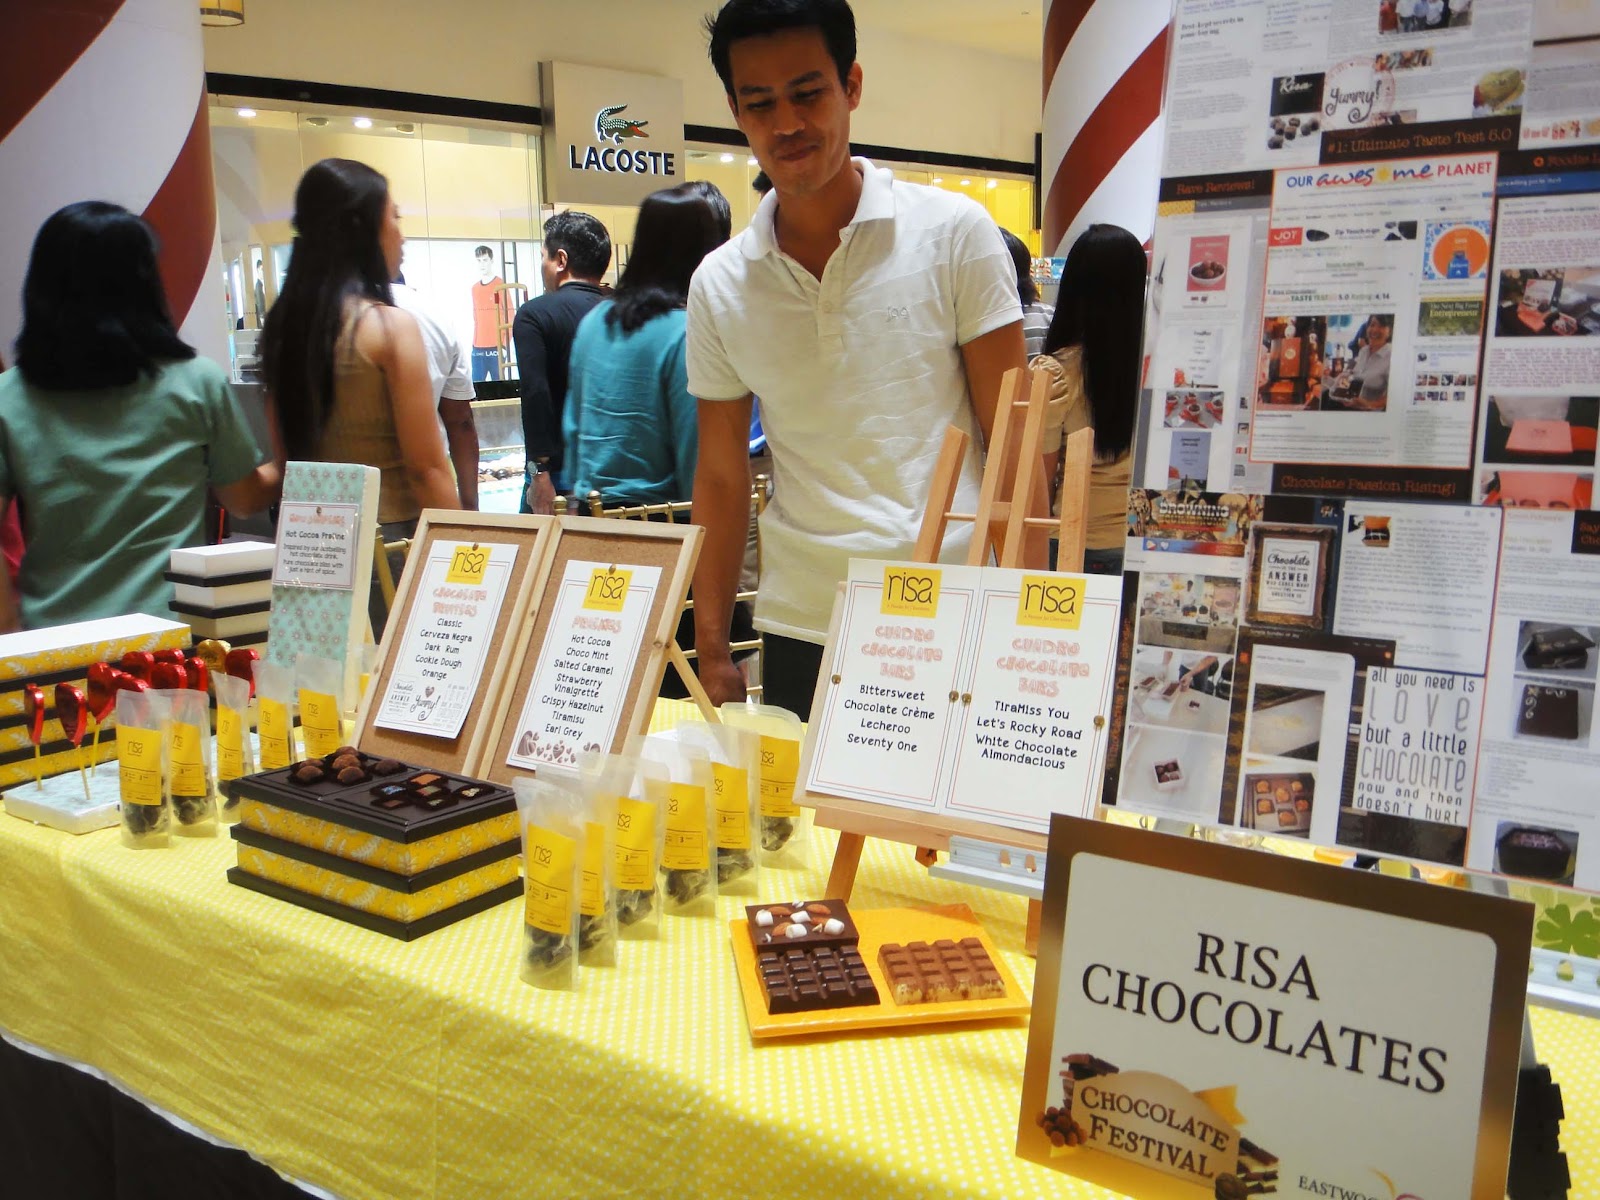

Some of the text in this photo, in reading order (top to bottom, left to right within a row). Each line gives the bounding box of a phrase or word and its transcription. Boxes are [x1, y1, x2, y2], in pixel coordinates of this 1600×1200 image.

[1351, 137, 1411, 153] Ultimate
[1413, 134, 1451, 148] Taste
[1455, 130, 1485, 144] Test
[569, 144, 675, 176] LACOSTE
[1286, 175, 1313, 188] OUR
[1437, 161, 1492, 178] PLANET
[1280, 475, 1456, 495] Chocolate Passion Rising!
[286, 530, 297, 538] Hot
[299, 530, 320, 539] Cocoa
[452, 549, 485, 574] risa
[1268, 553, 1310, 566] Chocolate
[589, 572, 625, 600] risa
[1268, 572, 1308, 582] ANSWER
[888, 572, 933, 604] risa
[1025, 580, 1076, 615] risa
[437, 618, 462, 628] Classic
[420, 629, 472, 643] Cerveza Negra
[571, 634, 611, 647] Hot Cocoa
[425, 642, 460, 654] Dark Rum
[566, 647, 609, 661] Choco Mint
[415, 655, 462, 669] Cookie Dough
[554, 659, 614, 675] Salted Caramel
[422, 669, 447, 680] Orange
[556, 673, 603, 690] Strawberry
[1371, 669, 1388, 683] all
[1395, 672, 1417, 688] you
[1424, 675, 1455, 691] need
[554, 683, 600, 698] Vinaigrette
[859, 684, 925, 701] Bittersweet
[541, 695, 604, 713] Crispy Hazelnut
[844, 699, 935, 719] Chocolate Crème
[1048, 707, 1070, 720] You
[552, 710, 585, 724] Tiramisu
[860, 718, 911, 733] Lecheroo
[545, 723, 583, 740] Earl Grey
[976, 716, 1083, 740] Let's Rocky Road
[847, 733, 918, 752] Seventy One
[975, 733, 1078, 758] White Chocolate
[1366, 723, 1467, 755] but a little
[981, 748, 1066, 770] Almondacious
[1358, 782, 1462, 806] now and then
[1357, 794, 1413, 816] doesn't
[1194, 932, 1320, 1001] RISA
[1081, 963, 1449, 1094] CHOCOLATES
[1080, 1085, 1231, 1152] CHOCOLATE
[1088, 1114, 1215, 1180] FESTIVAL
